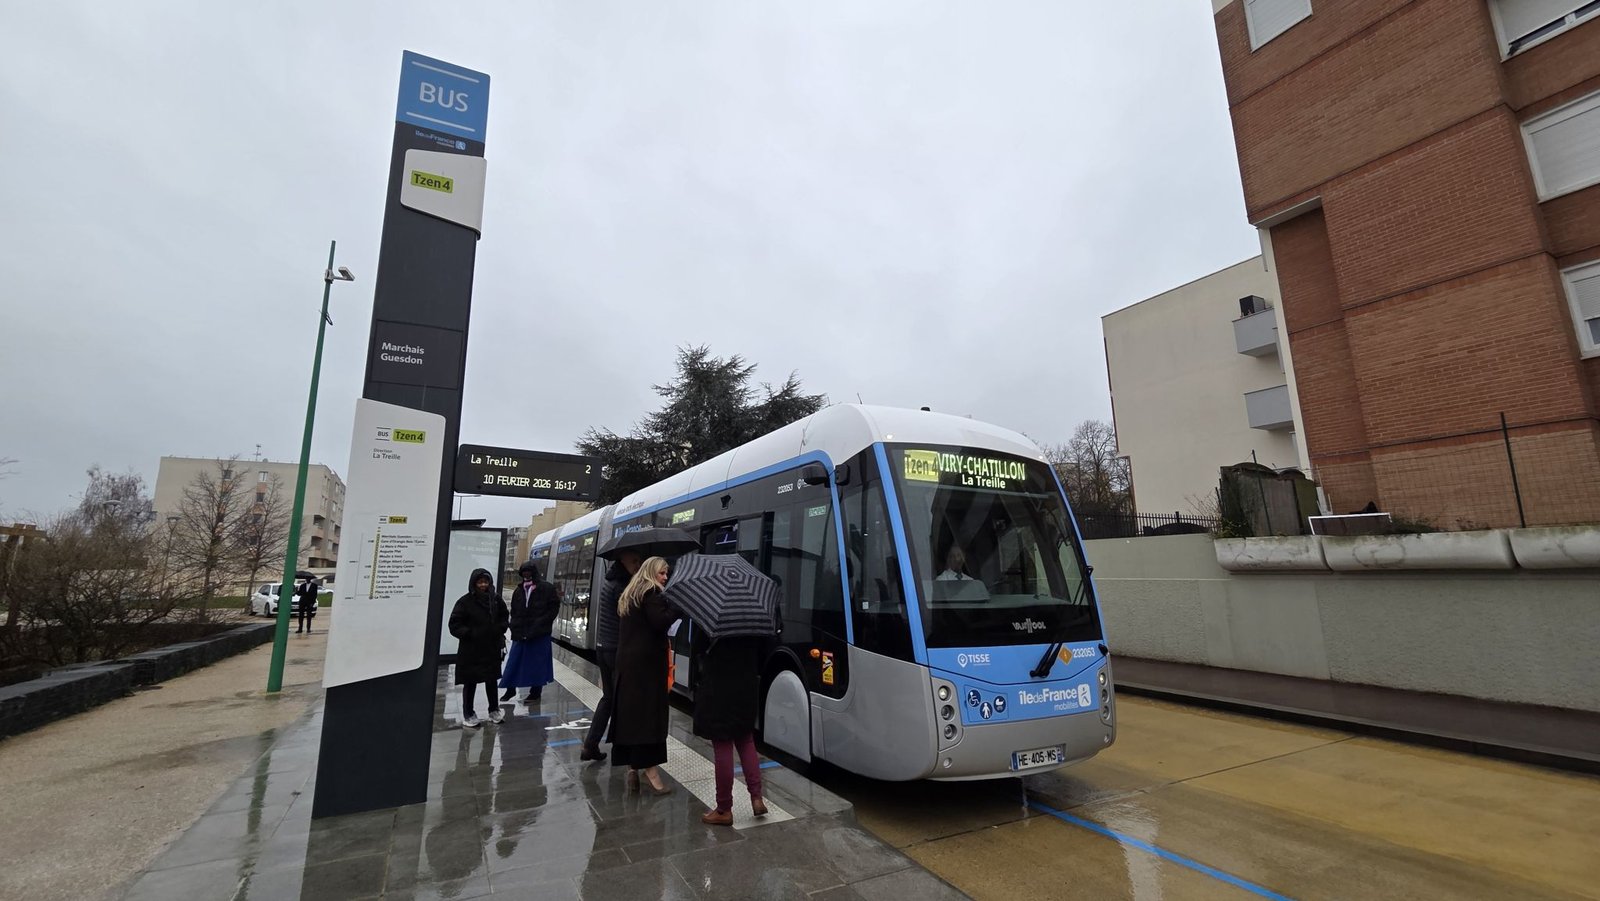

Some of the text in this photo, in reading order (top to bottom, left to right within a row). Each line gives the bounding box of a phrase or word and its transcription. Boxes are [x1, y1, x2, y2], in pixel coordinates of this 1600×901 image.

[418, 81, 469, 112] BUS
[442, 178, 450, 191] 4
[381, 342, 425, 355] Marchais
[380, 352, 423, 365] Guesdon
[470, 454, 591, 474] La Treille 2
[938, 453, 1026, 481] VIRY-CHATILLON
[483, 474, 577, 491] 10 FEVRIER 2026 16:17
[961, 475, 1006, 489] La Treille
[968, 653, 990, 663] TISSE
[1072, 647, 1096, 658] 232053
